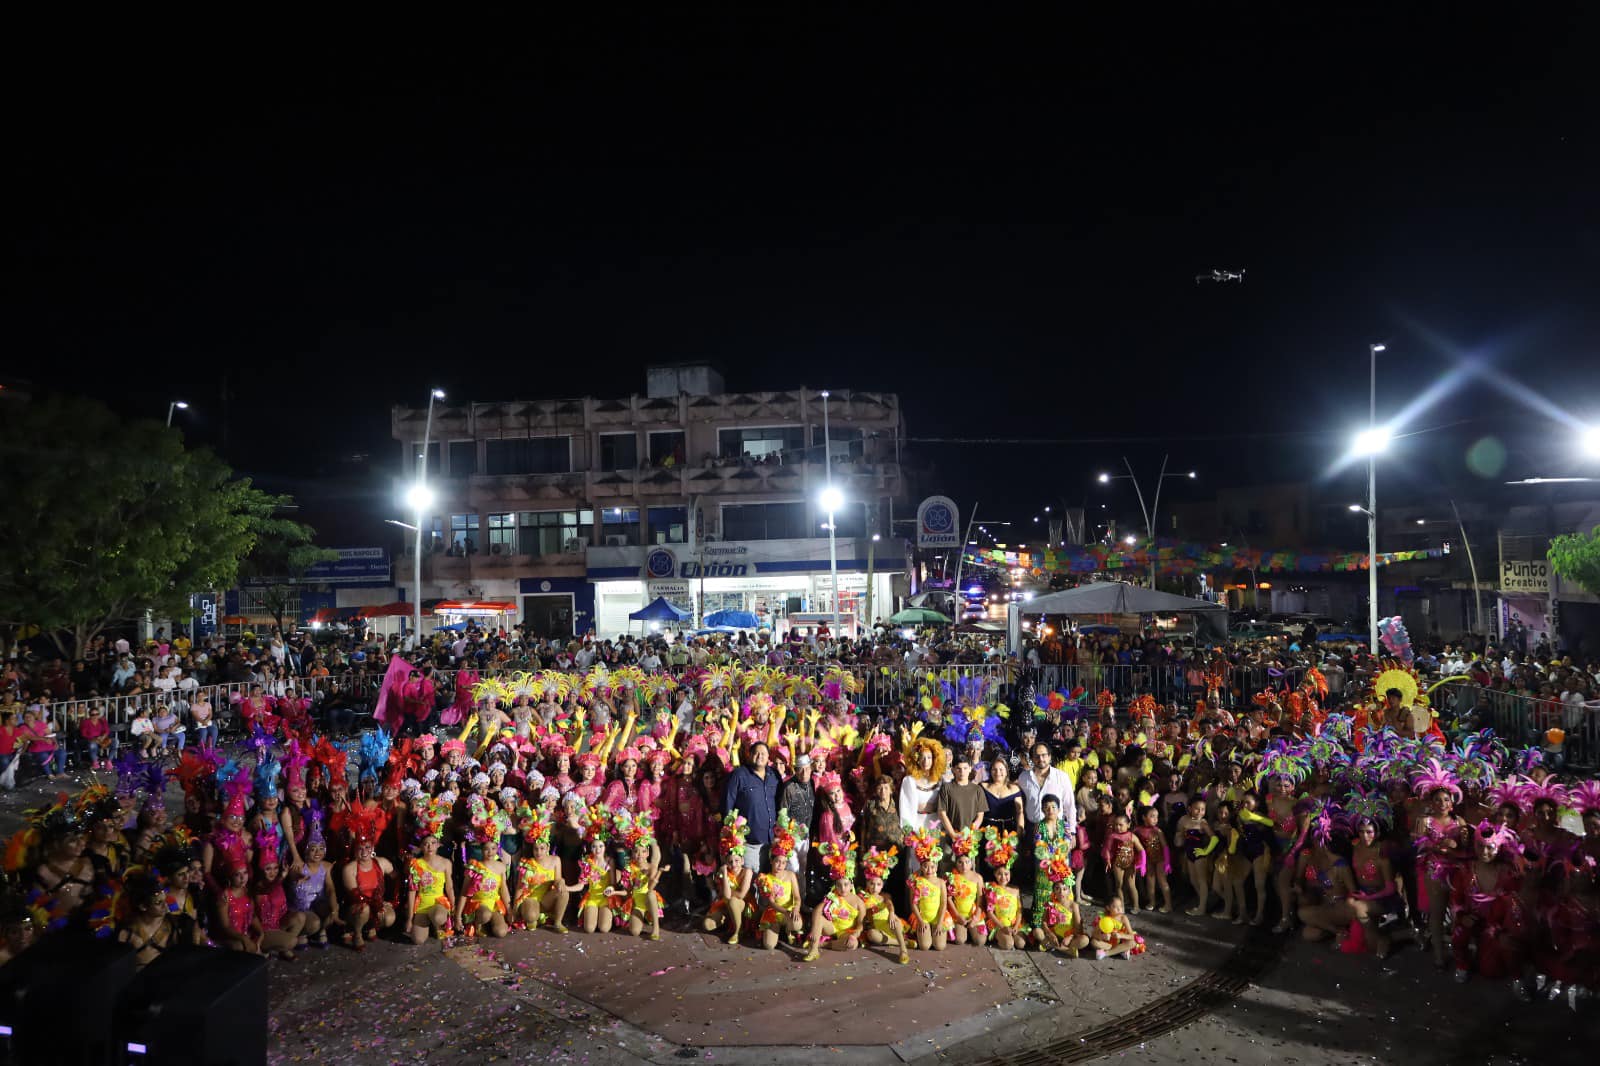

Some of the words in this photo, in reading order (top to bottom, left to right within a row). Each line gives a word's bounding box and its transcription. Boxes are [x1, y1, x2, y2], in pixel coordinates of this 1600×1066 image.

[680, 560, 748, 578] Unión
[1503, 560, 1547, 577] Punto
[1504, 577, 1548, 587] Creativo
